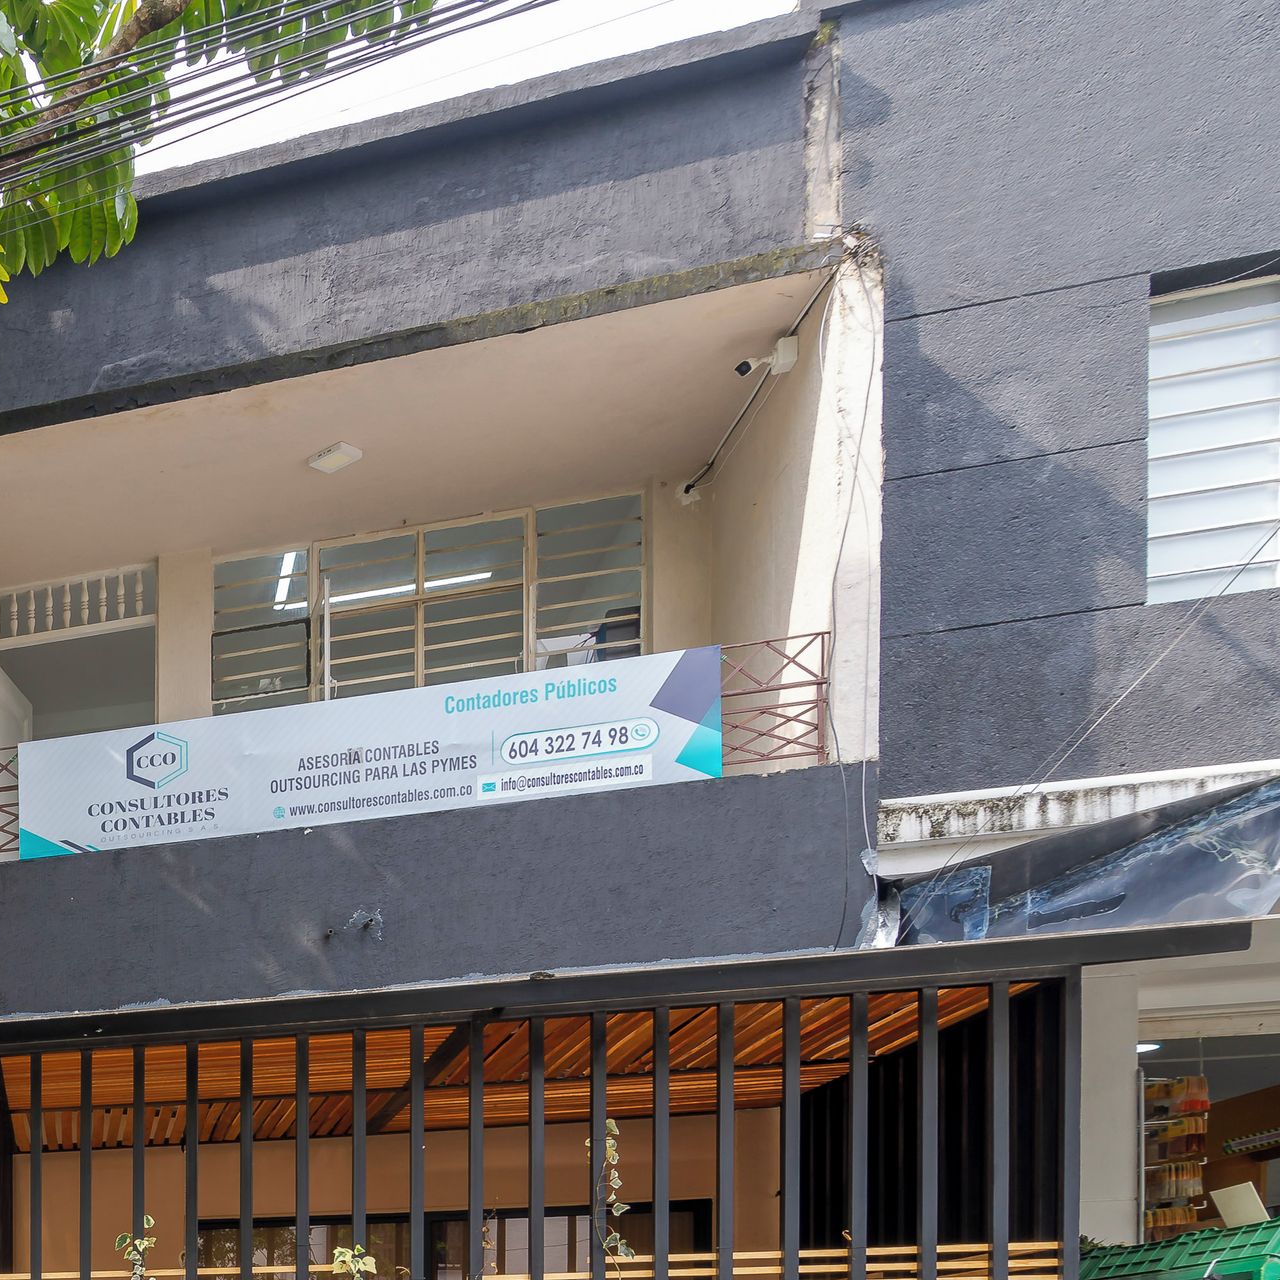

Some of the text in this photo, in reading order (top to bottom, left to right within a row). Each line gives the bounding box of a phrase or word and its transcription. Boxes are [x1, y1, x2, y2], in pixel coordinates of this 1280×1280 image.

[444, 677, 618, 714] Contadores Públicos
[297, 740, 440, 772] ASESORÍA CONTABLES
[508, 726, 629, 760] 604 322 74 98
[136, 751, 177, 769] CCO
[270, 754, 478, 794] OUTSOURCING PARA LAS PYMES
[500, 763, 644, 792] info@consultorescontables.com.co
[87, 787, 229, 817] CONSULTORES
[289, 784, 473, 817] www.consultorescontables.com.co
[100, 807, 216, 834] CONTABLES
[100, 827, 182, 843] OUTSOURCING
